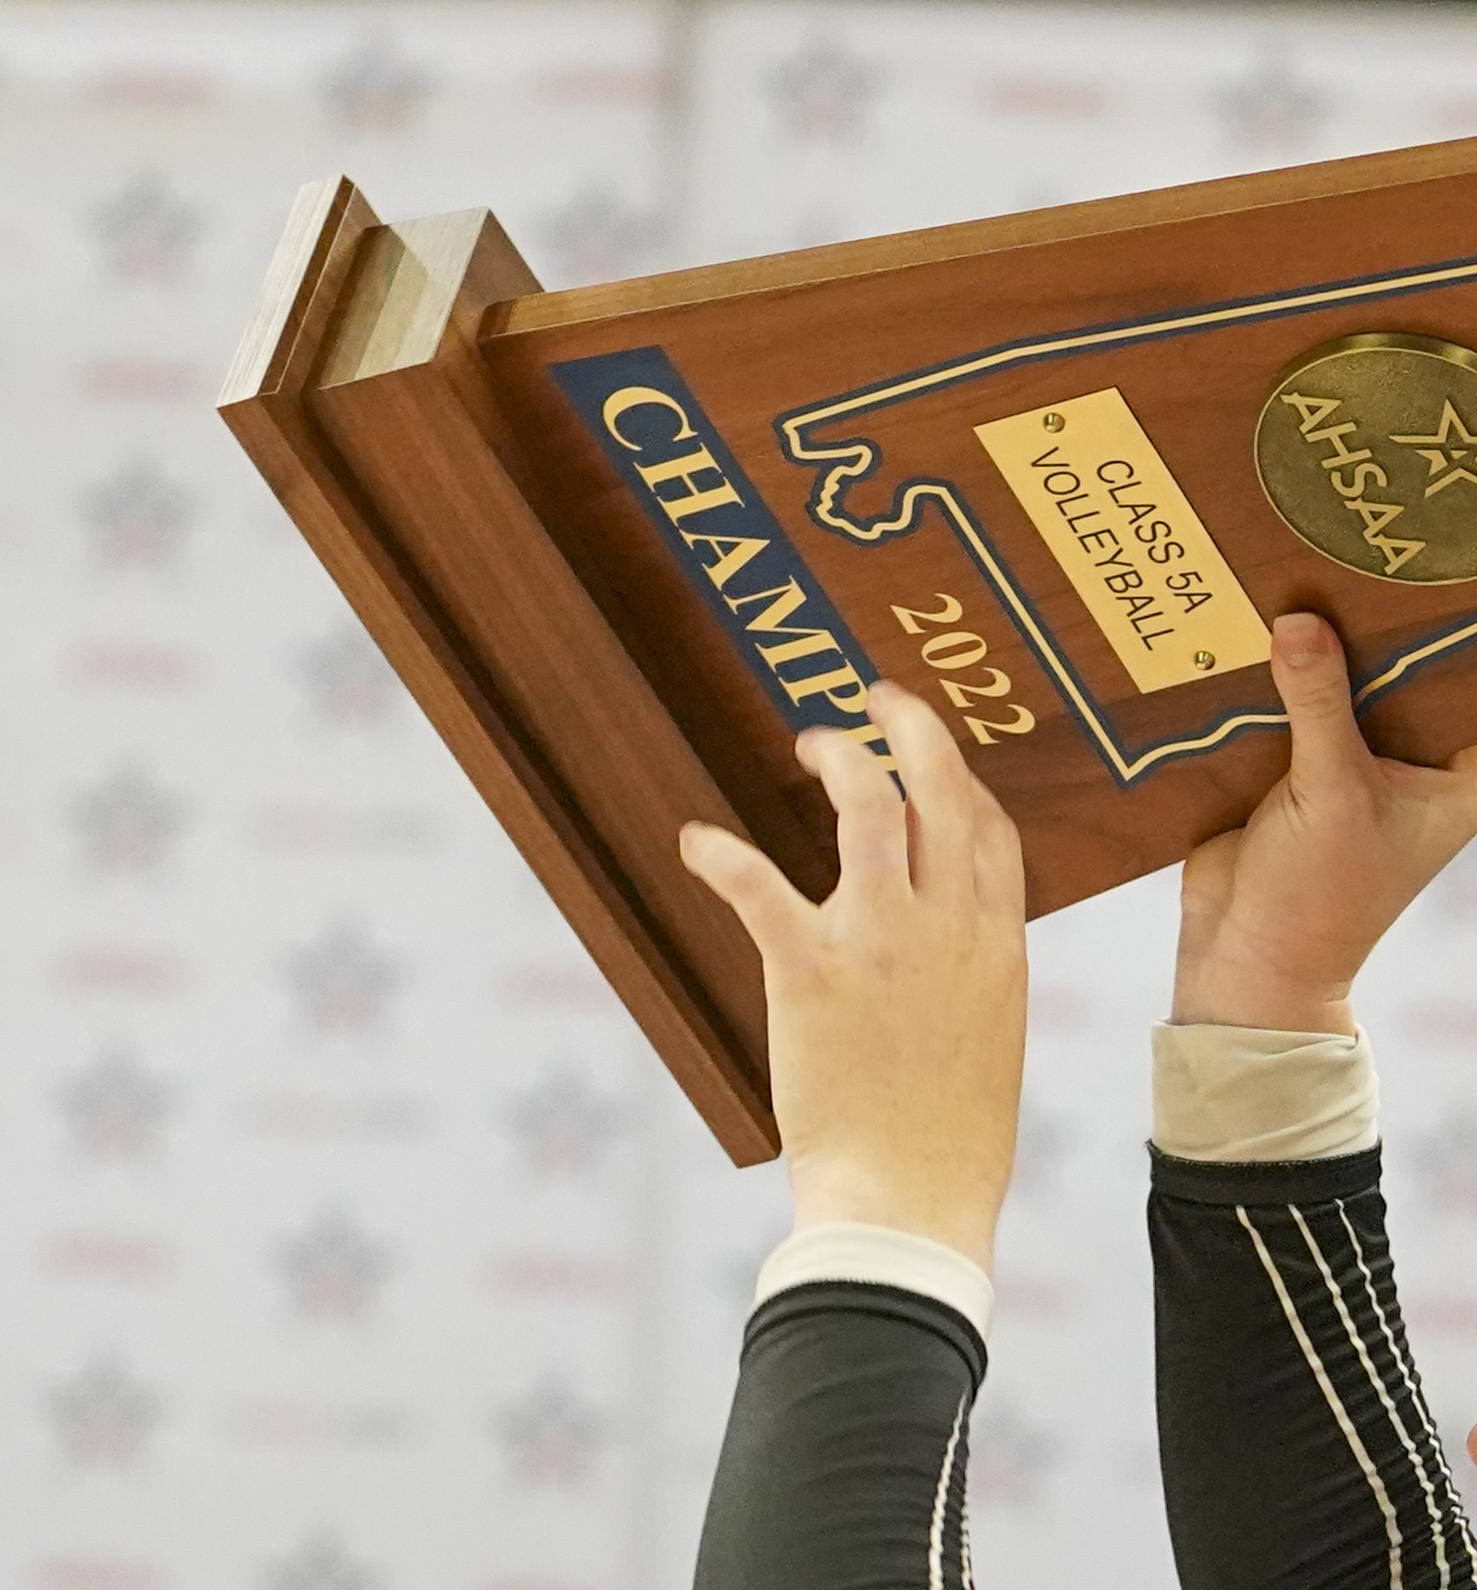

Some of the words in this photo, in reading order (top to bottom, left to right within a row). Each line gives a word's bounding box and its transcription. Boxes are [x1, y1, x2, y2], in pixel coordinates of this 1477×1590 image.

[1030, 446, 1175, 652] VOLLEYBALL
[1096, 459, 1186, 565] CLASS
[1165, 570, 1213, 615] 5A
[1279, 391, 1427, 576] AHSAA
[889, 592, 1036, 746] 2022
